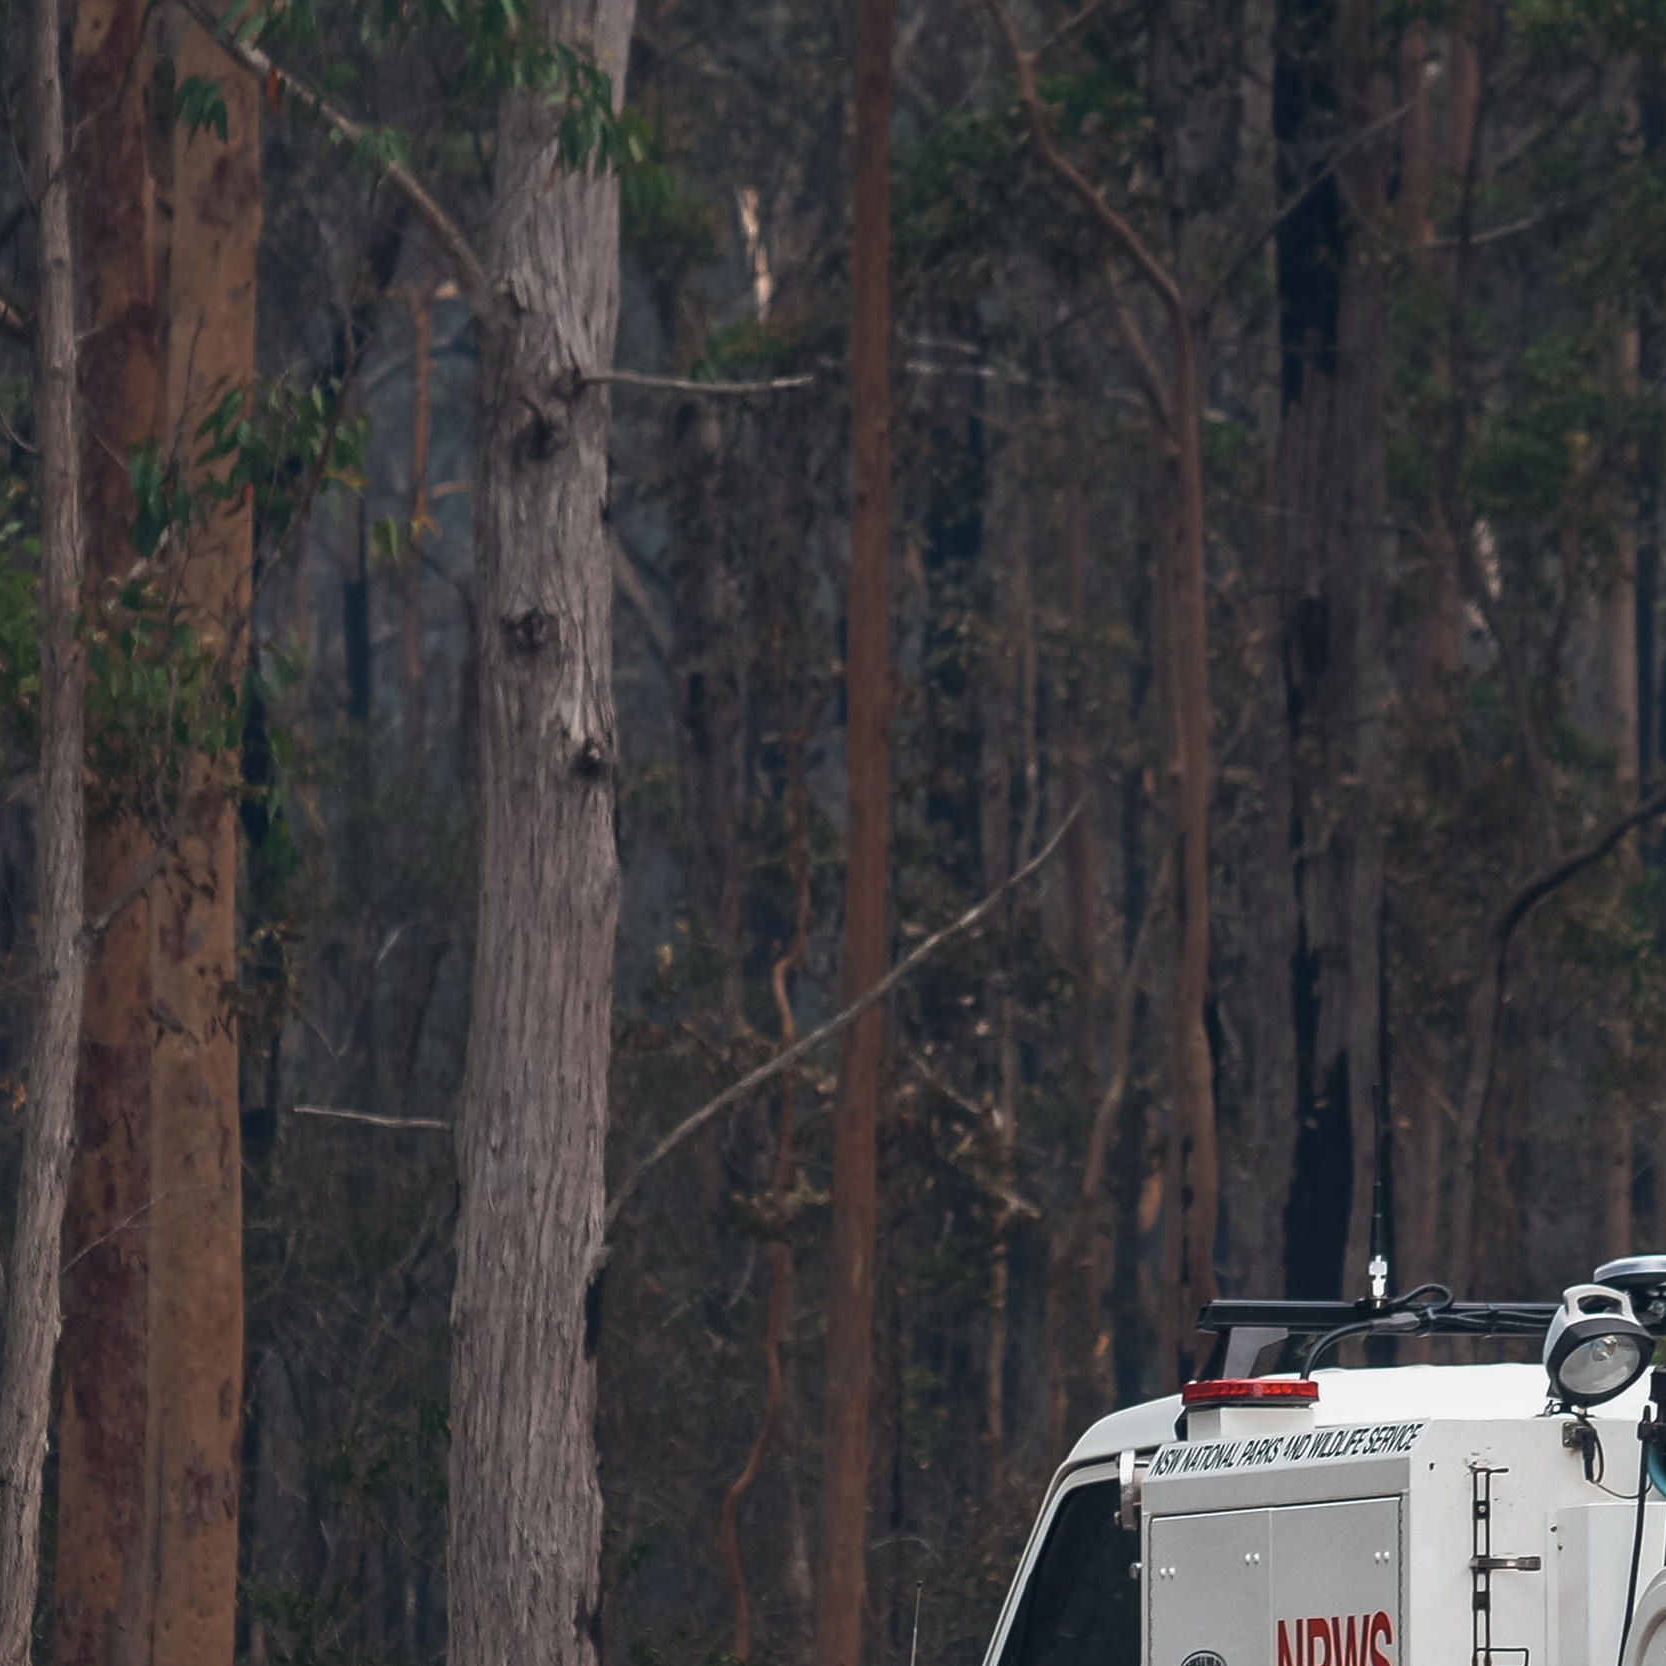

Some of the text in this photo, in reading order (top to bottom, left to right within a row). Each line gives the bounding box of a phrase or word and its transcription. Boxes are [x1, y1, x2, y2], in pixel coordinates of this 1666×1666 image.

[1150, 1449, 1182, 1476] NSW
[1181, 1442, 1240, 1473] NATIONAL
[1236, 1437, 1284, 1465] PARKS
[1308, 1427, 1370, 1459] WILDLIFE
[1364, 1423, 1424, 1454] SERVICE
